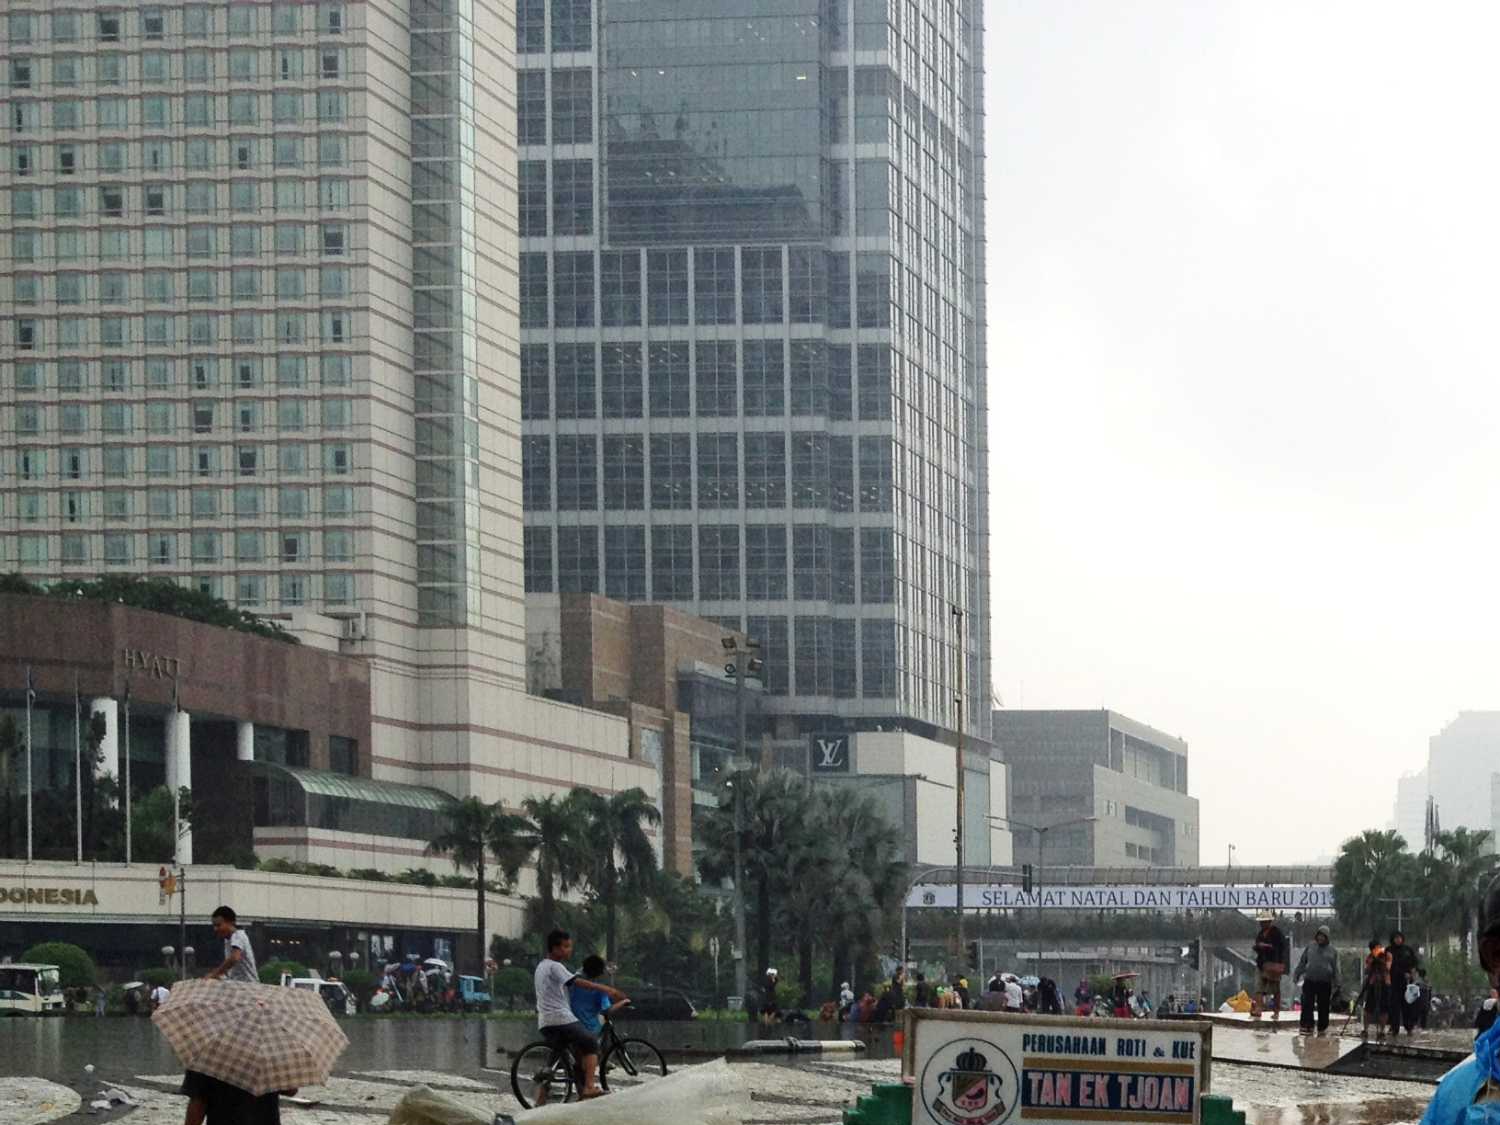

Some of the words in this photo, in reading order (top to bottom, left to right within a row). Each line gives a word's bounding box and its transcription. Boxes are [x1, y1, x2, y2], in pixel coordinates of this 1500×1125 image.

[125, 648, 181, 680] HYATT
[981, 890, 1066, 906] SELAMAT
[1071, 890, 1130, 906] NATAL
[1134, 890, 1171, 906] DAN
[1176, 890, 1240, 906] TAHUN
[1246, 890, 1295, 906] BARU
[1022, 1033, 1106, 1056] PERUSAHAAN
[1117, 1038, 1147, 1057] ROTI
[1153, 1046, 1165, 1058] &
[1172, 1040, 1195, 1059] KUE
[1027, 1071, 1072, 1106] TAN
[1079, 1072, 1110, 1107] EK
[1117, 1075, 1190, 1111] TJOAN
